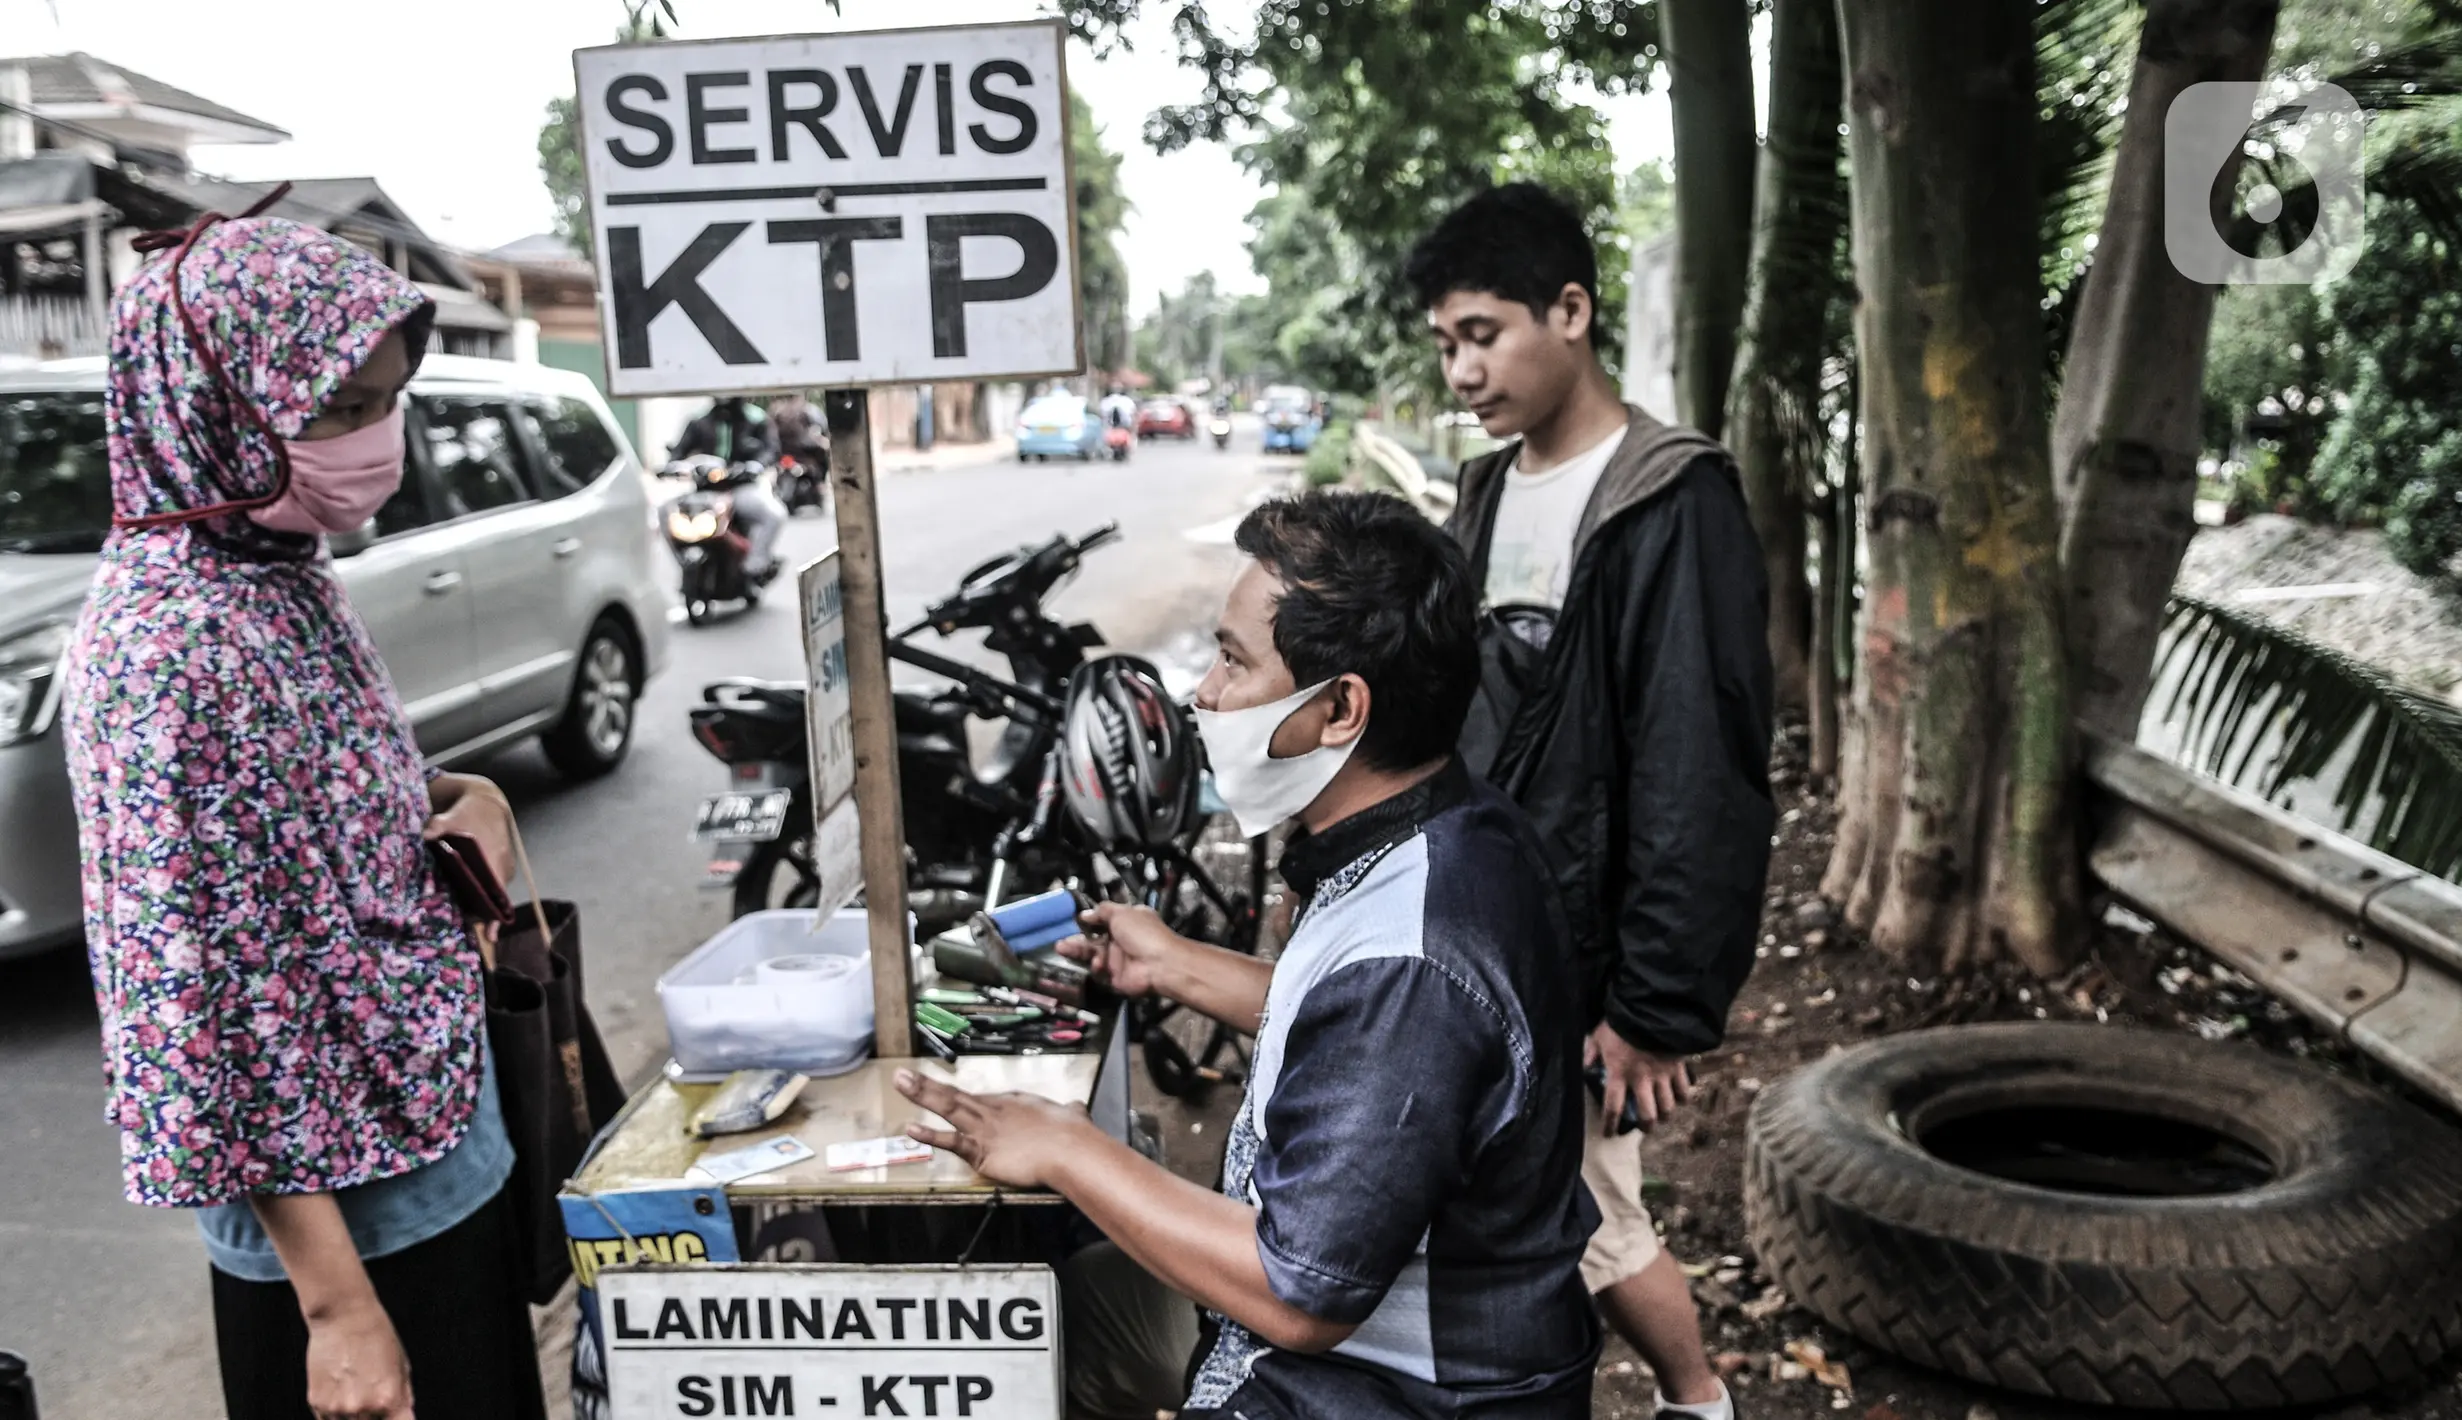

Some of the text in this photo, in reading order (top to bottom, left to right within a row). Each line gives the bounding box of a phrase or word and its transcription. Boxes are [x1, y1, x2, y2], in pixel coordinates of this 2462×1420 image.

[604, 59, 1038, 169] SERVIS
[606, 212, 1060, 370] KTP
[612, 1297, 1046, 1341] LAMINATING
[676, 1375, 795, 1417] SIM
[861, 1375, 994, 1417] KTP
